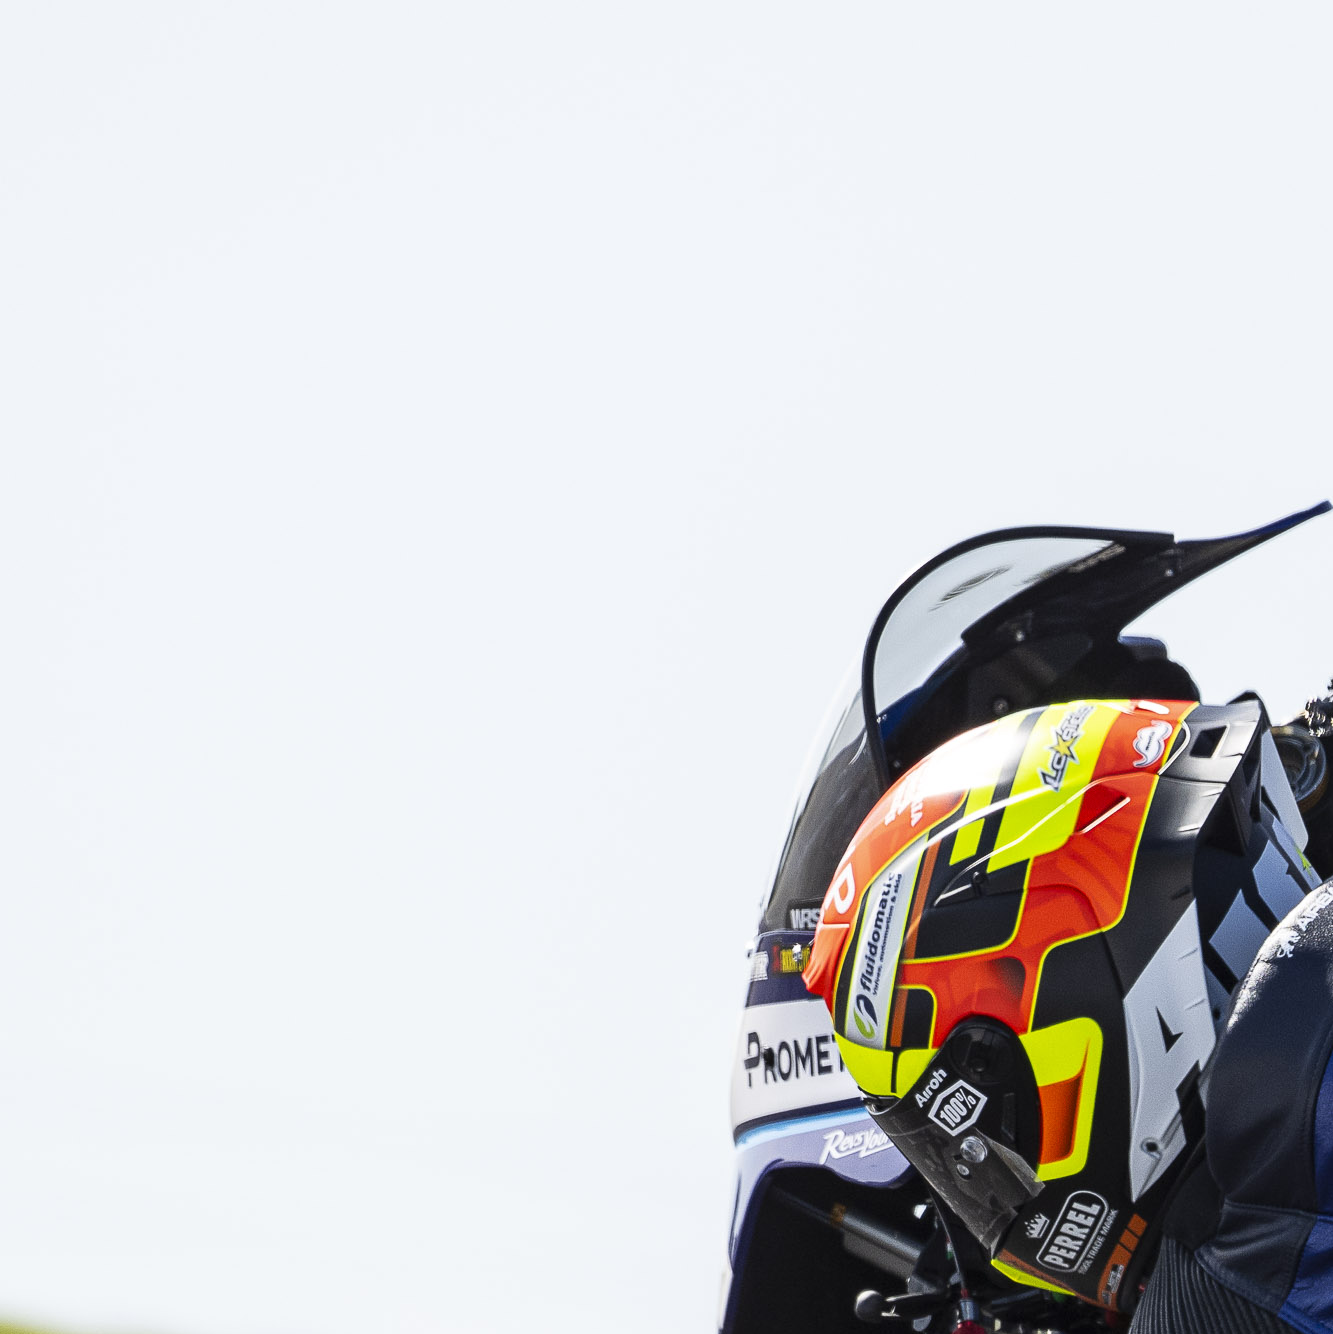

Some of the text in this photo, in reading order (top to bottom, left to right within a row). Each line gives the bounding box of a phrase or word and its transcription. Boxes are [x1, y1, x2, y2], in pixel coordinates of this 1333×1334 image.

[915, 1068, 947, 1108] Airoh
[940, 1088, 977, 1128] 100%
[1043, 1202, 1101, 1268] PERREL
